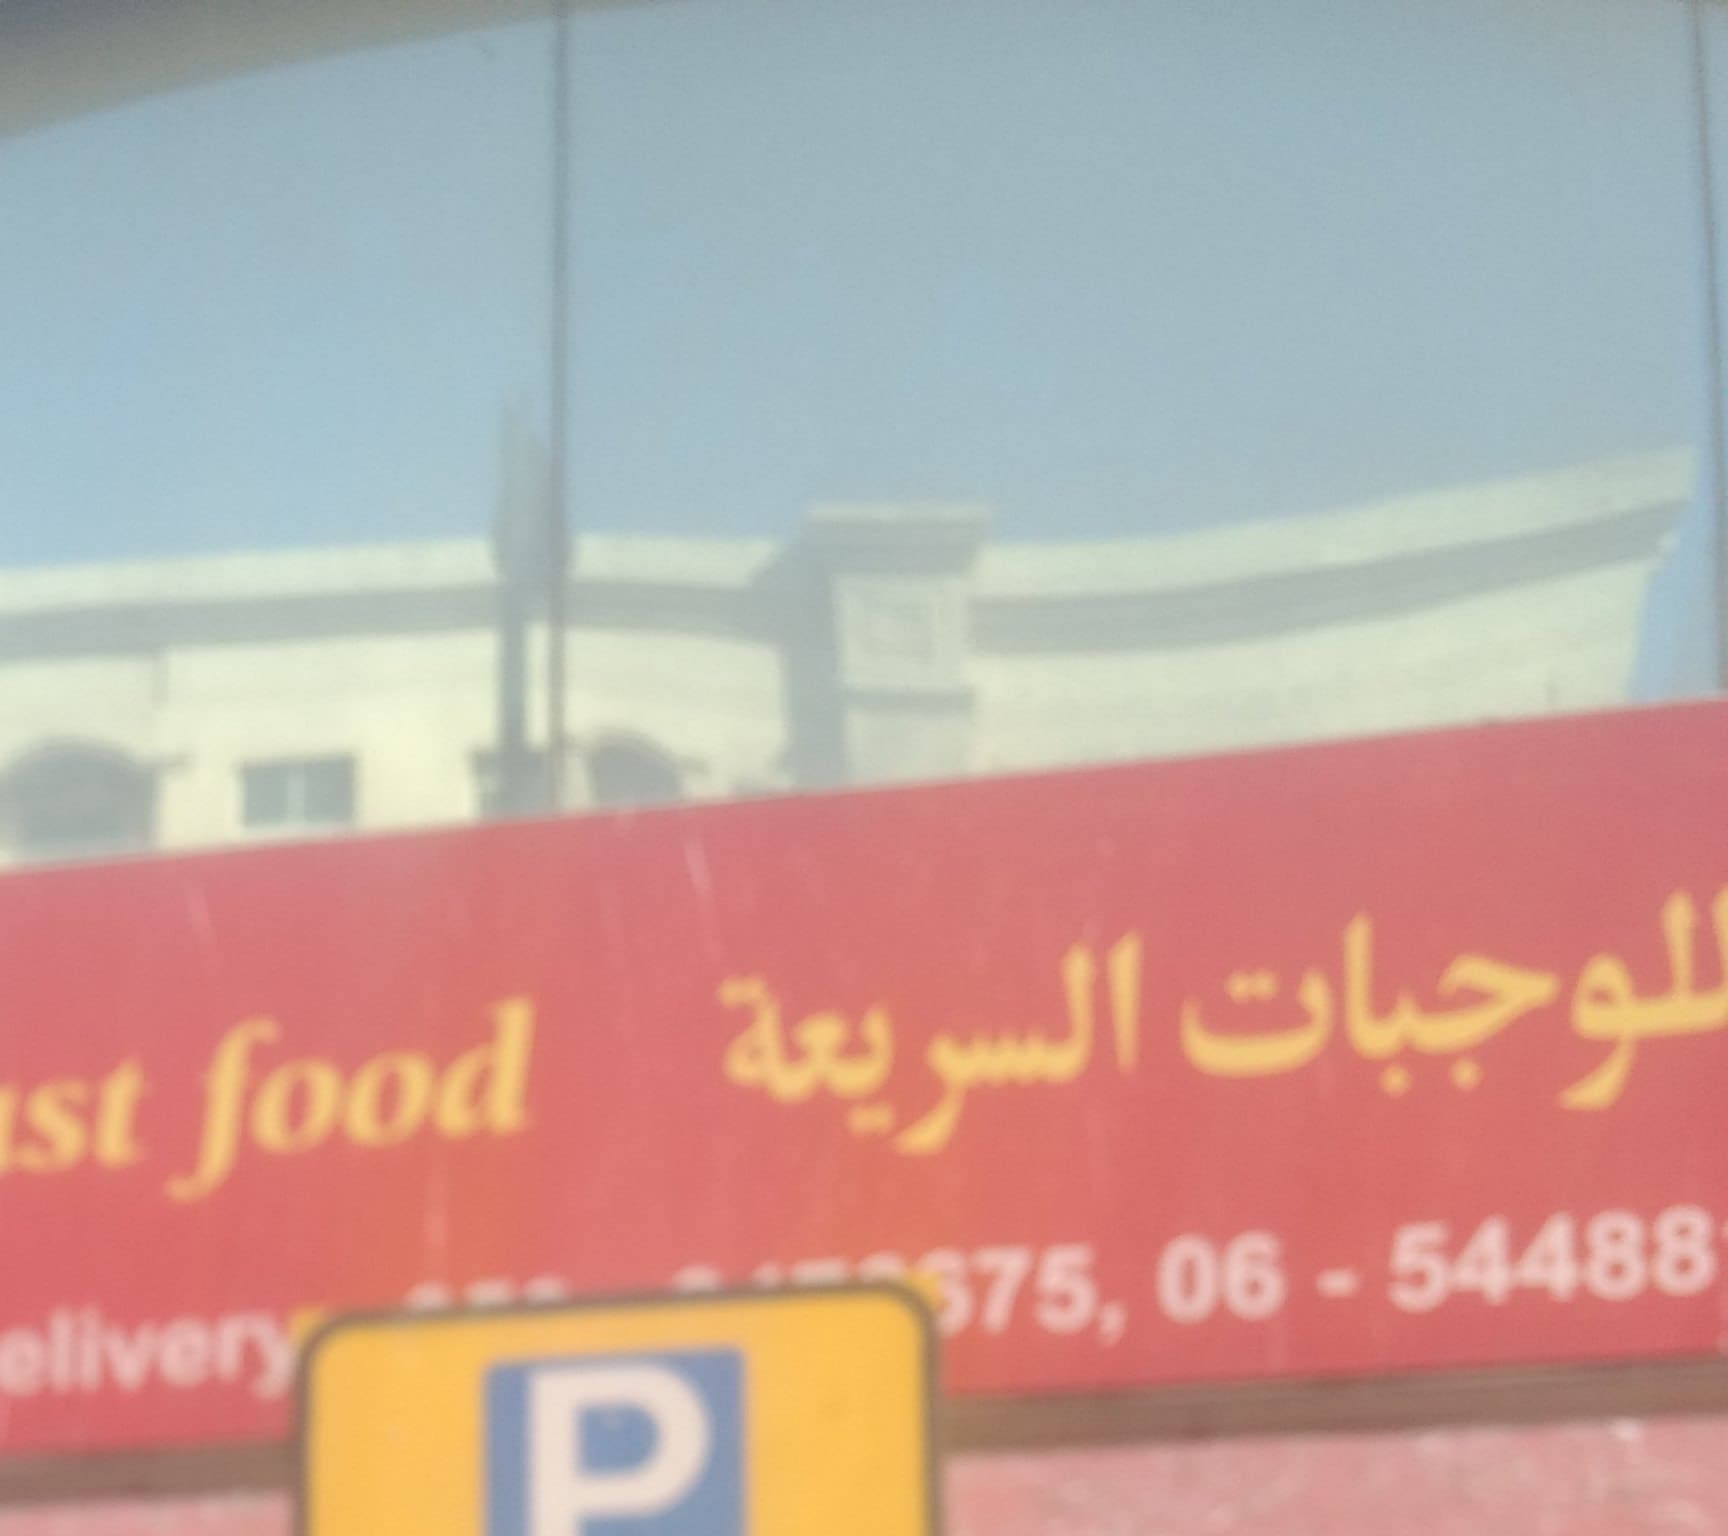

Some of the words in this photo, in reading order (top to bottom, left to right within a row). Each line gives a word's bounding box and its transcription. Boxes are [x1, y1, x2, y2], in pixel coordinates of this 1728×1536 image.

[165, 998, 534, 1200] food
[717, 932, 1144, 1157] السريعة
[1157, 1232, 1286, 1320] 06
[1388, 1205, 1728, 1312] 54488
